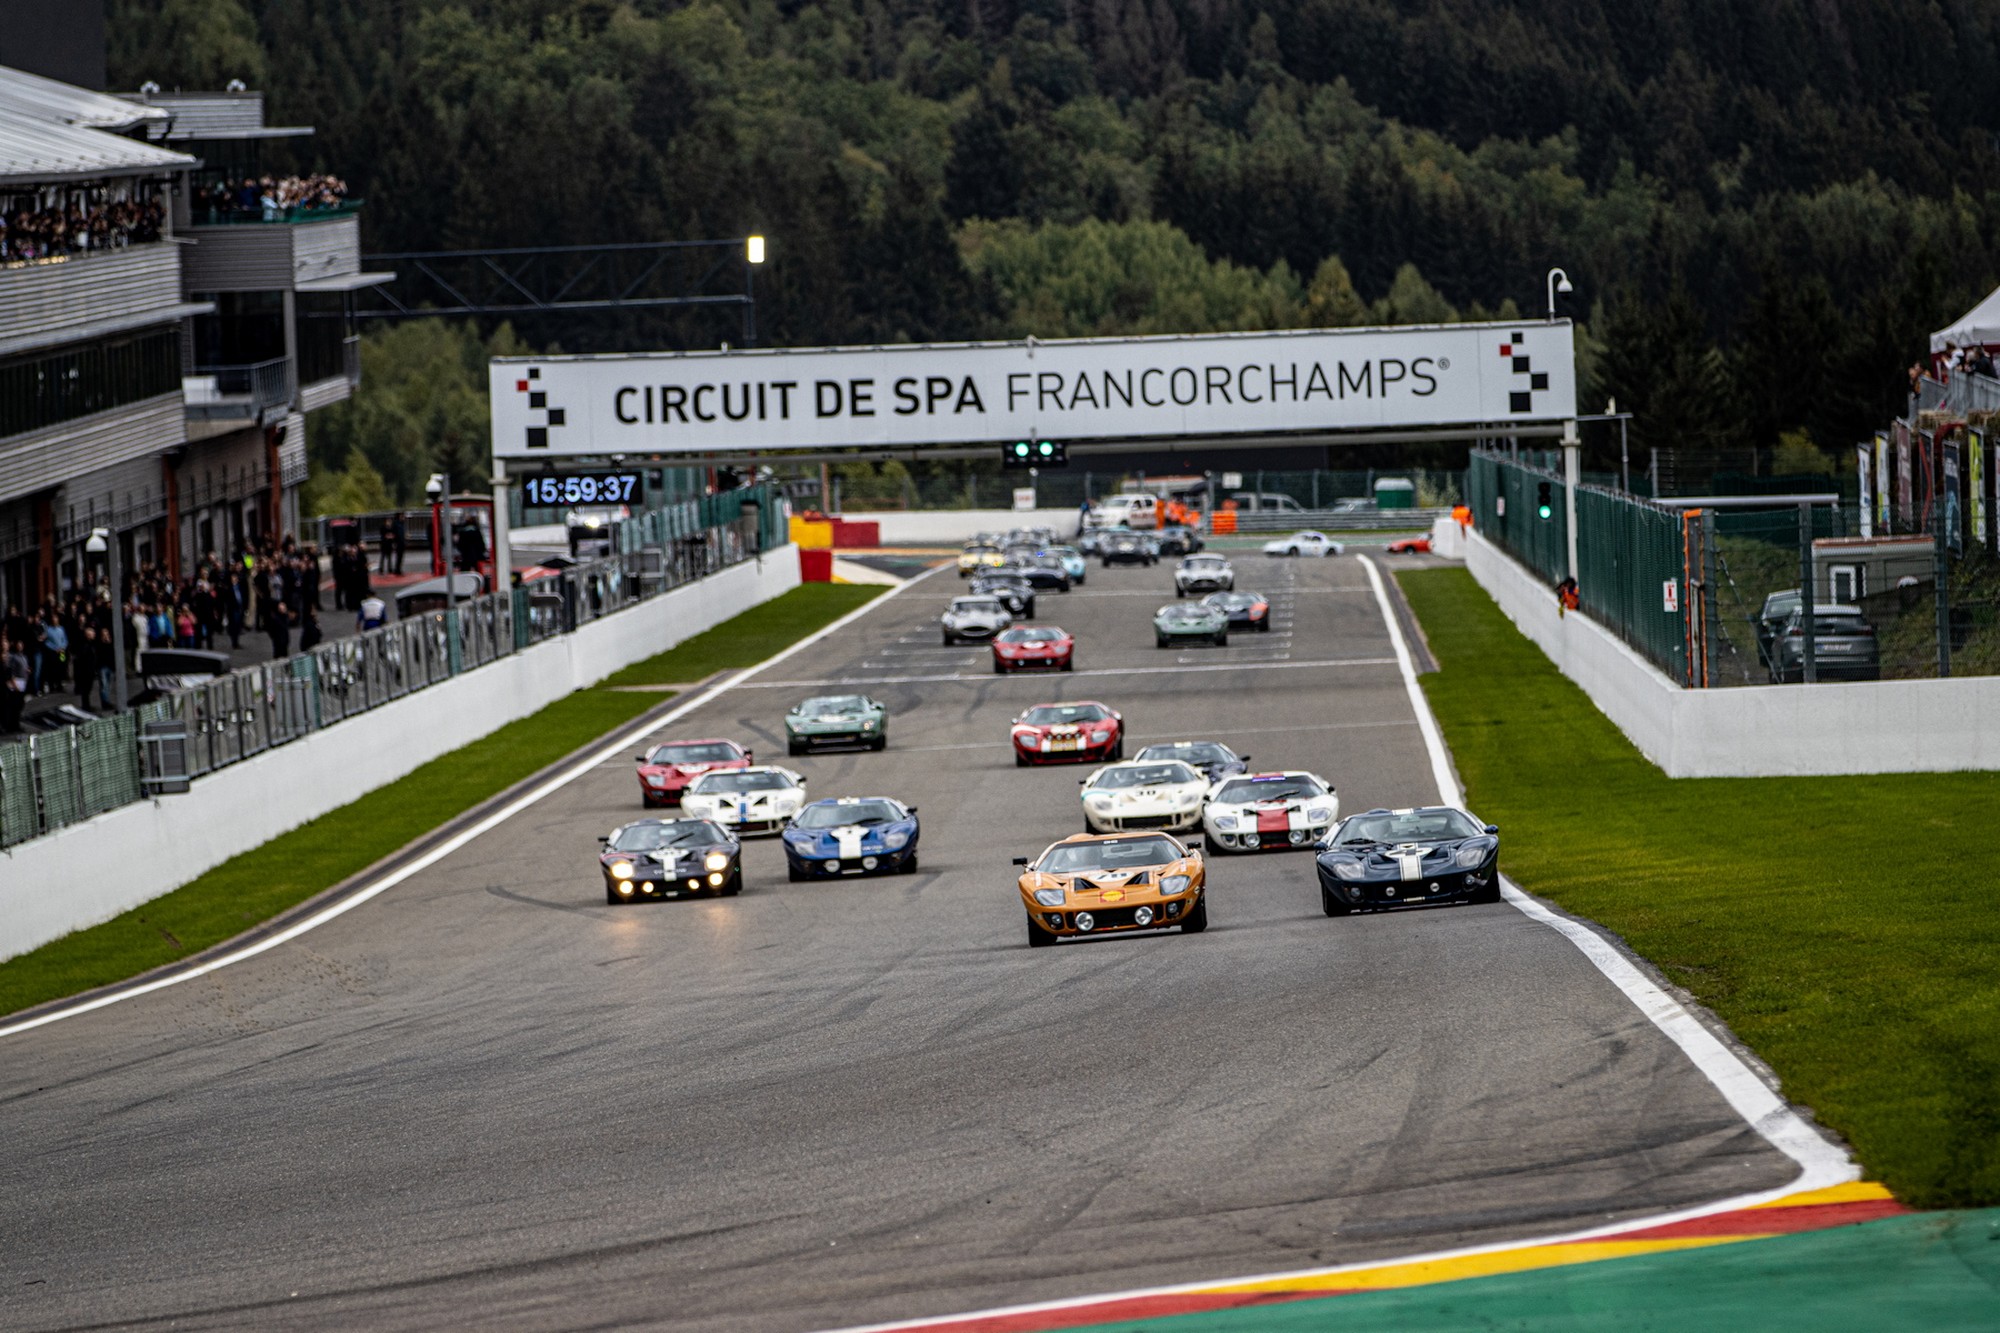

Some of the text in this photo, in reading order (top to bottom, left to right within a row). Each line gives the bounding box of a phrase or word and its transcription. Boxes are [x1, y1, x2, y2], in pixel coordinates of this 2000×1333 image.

[614, 379, 798, 425] CIRCUIT
[814, 378, 876, 419] DE
[893, 375, 986, 416] SPA
[526, 475, 637, 504] 15:59:37
